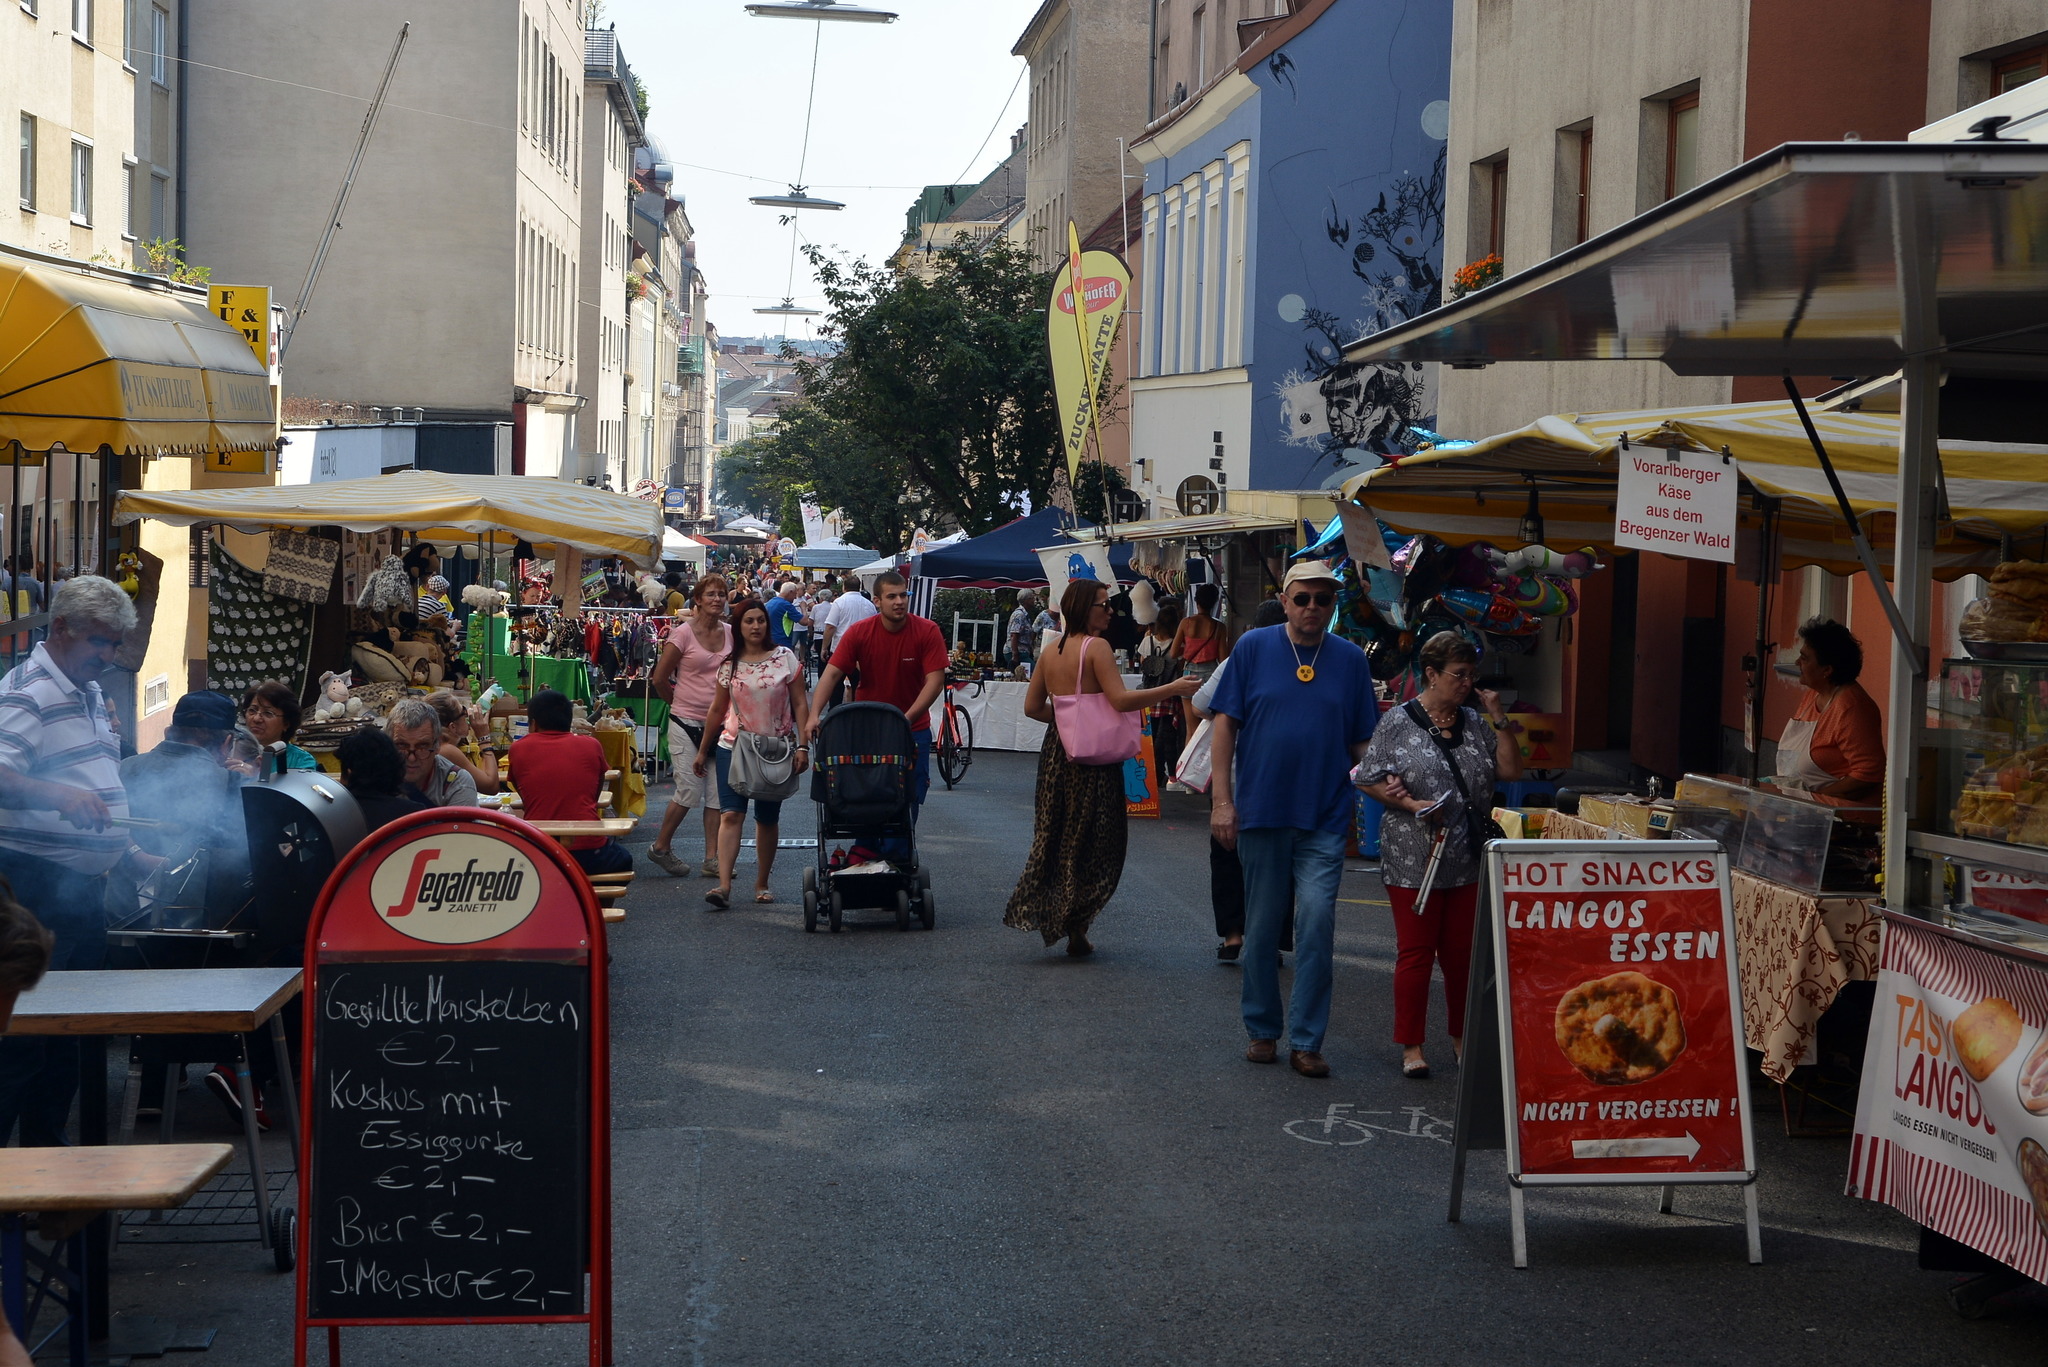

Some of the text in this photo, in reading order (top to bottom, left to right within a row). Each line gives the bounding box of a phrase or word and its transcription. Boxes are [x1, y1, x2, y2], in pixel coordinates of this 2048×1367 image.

[1063, 280, 1117, 310] WHOFER
[1068, 314, 1114, 451] ZUCKEWATTE
[1633, 457, 1721, 484] Vorarlberger
[1658, 482, 1692, 501] Käse
[1646, 505, 1703, 524] aus dem
[1620, 519, 1730, 549] Bregenzer Wald
[386, 848, 524, 918] Segafredo
[1503, 859, 1716, 887] HOT SNACKS
[448, 903, 497, 913] ZANETTI
[1507, 899, 1648, 929] LANGOS
[1609, 930, 1720, 962] ESSEN
[330, 1069, 511, 1118] Kuskus mit
[1523, 1102, 1590, 1121] NICHT
[1598, 1098, 1720, 1120] VERGESSEN
[359, 1120, 534, 1161] Essiggurke
[1913, 1120, 1938, 1138] ESSEN
[1940, 1129, 1959, 1146] NICHT
[1960, 1136, 1997, 1163] VERGESSEN!
[331, 1195, 417, 1247] Bier
